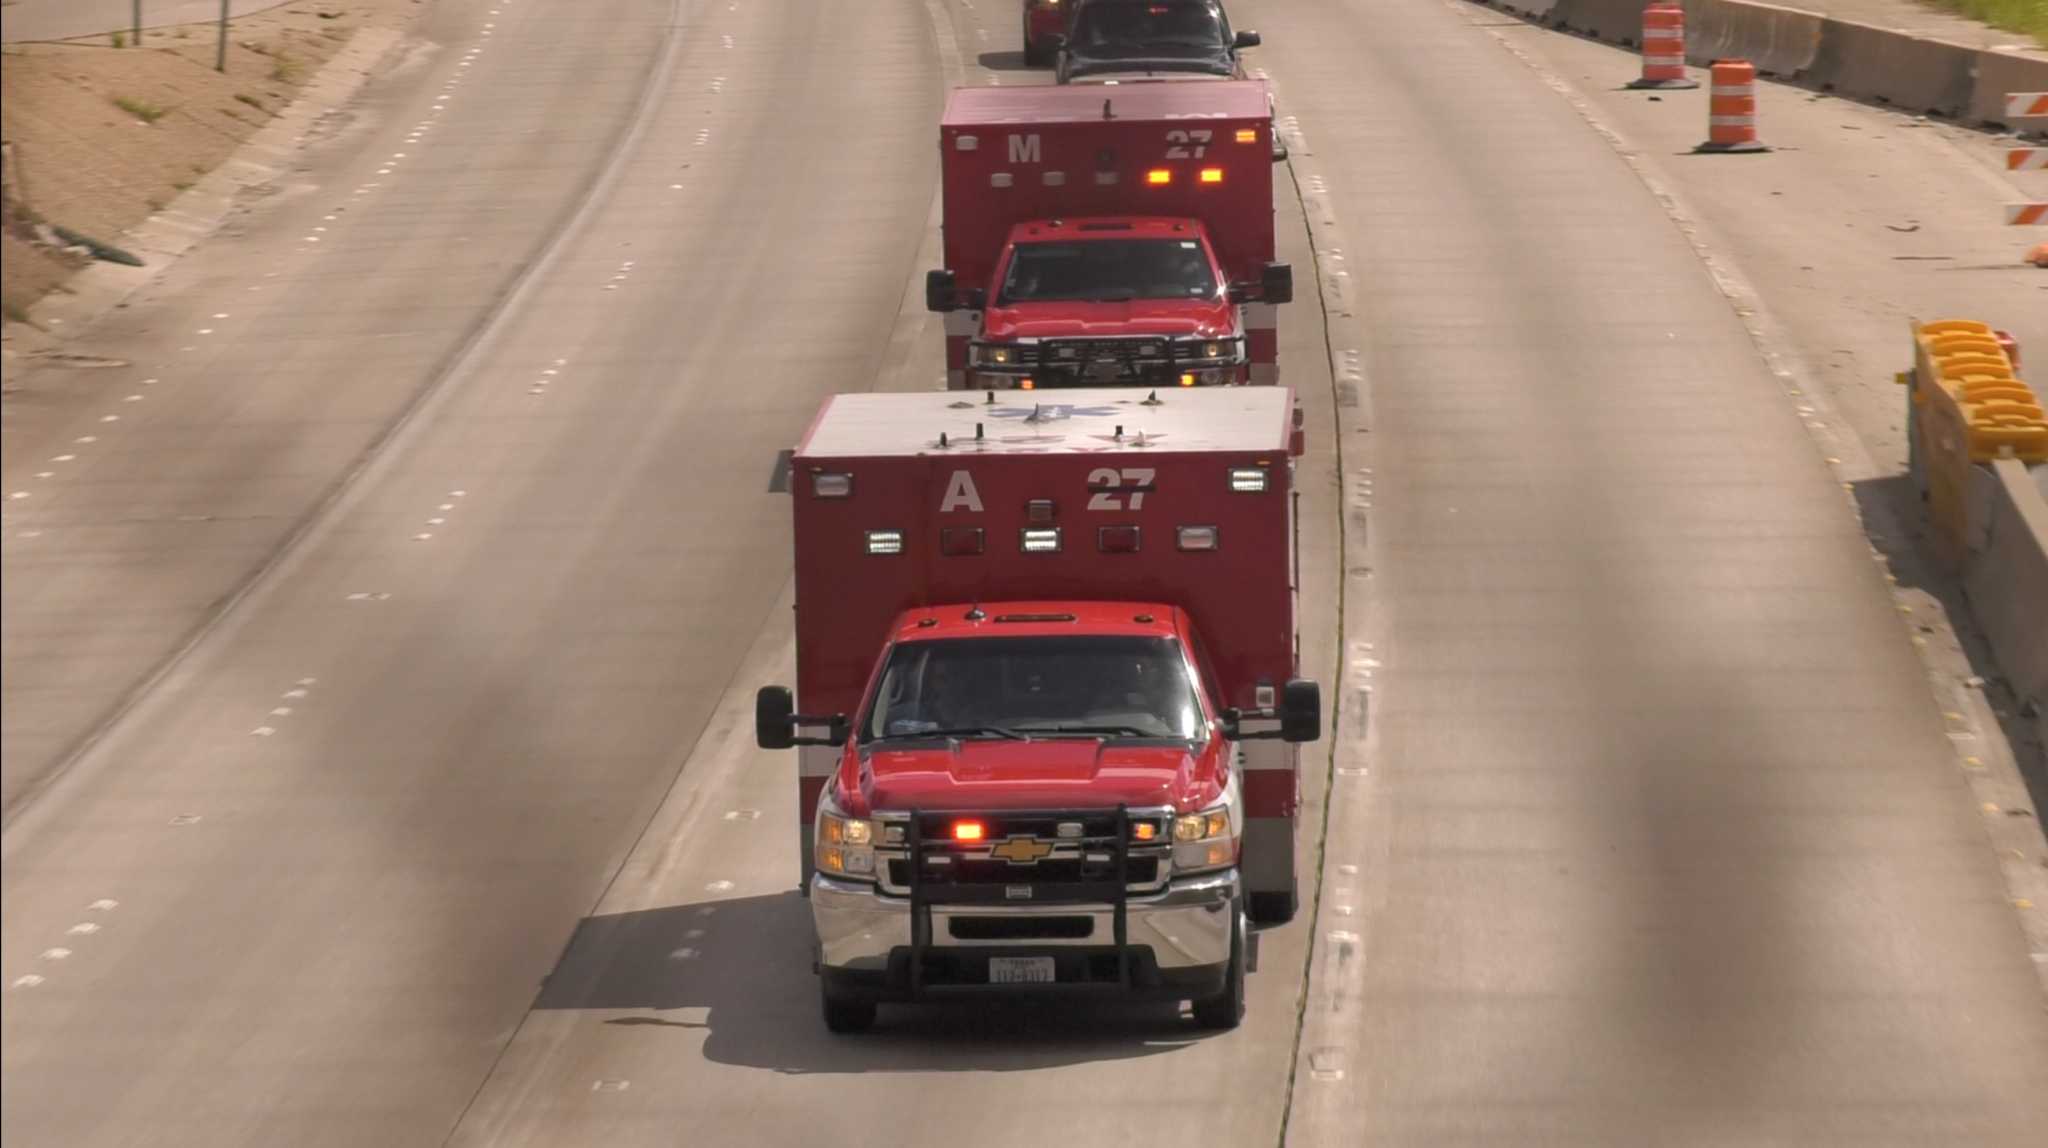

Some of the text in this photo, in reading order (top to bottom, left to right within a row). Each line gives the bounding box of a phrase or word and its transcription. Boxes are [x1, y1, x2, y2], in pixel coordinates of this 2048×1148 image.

[1008, 129, 1213, 163] M 27
[940, 467, 1156, 512] A 27
